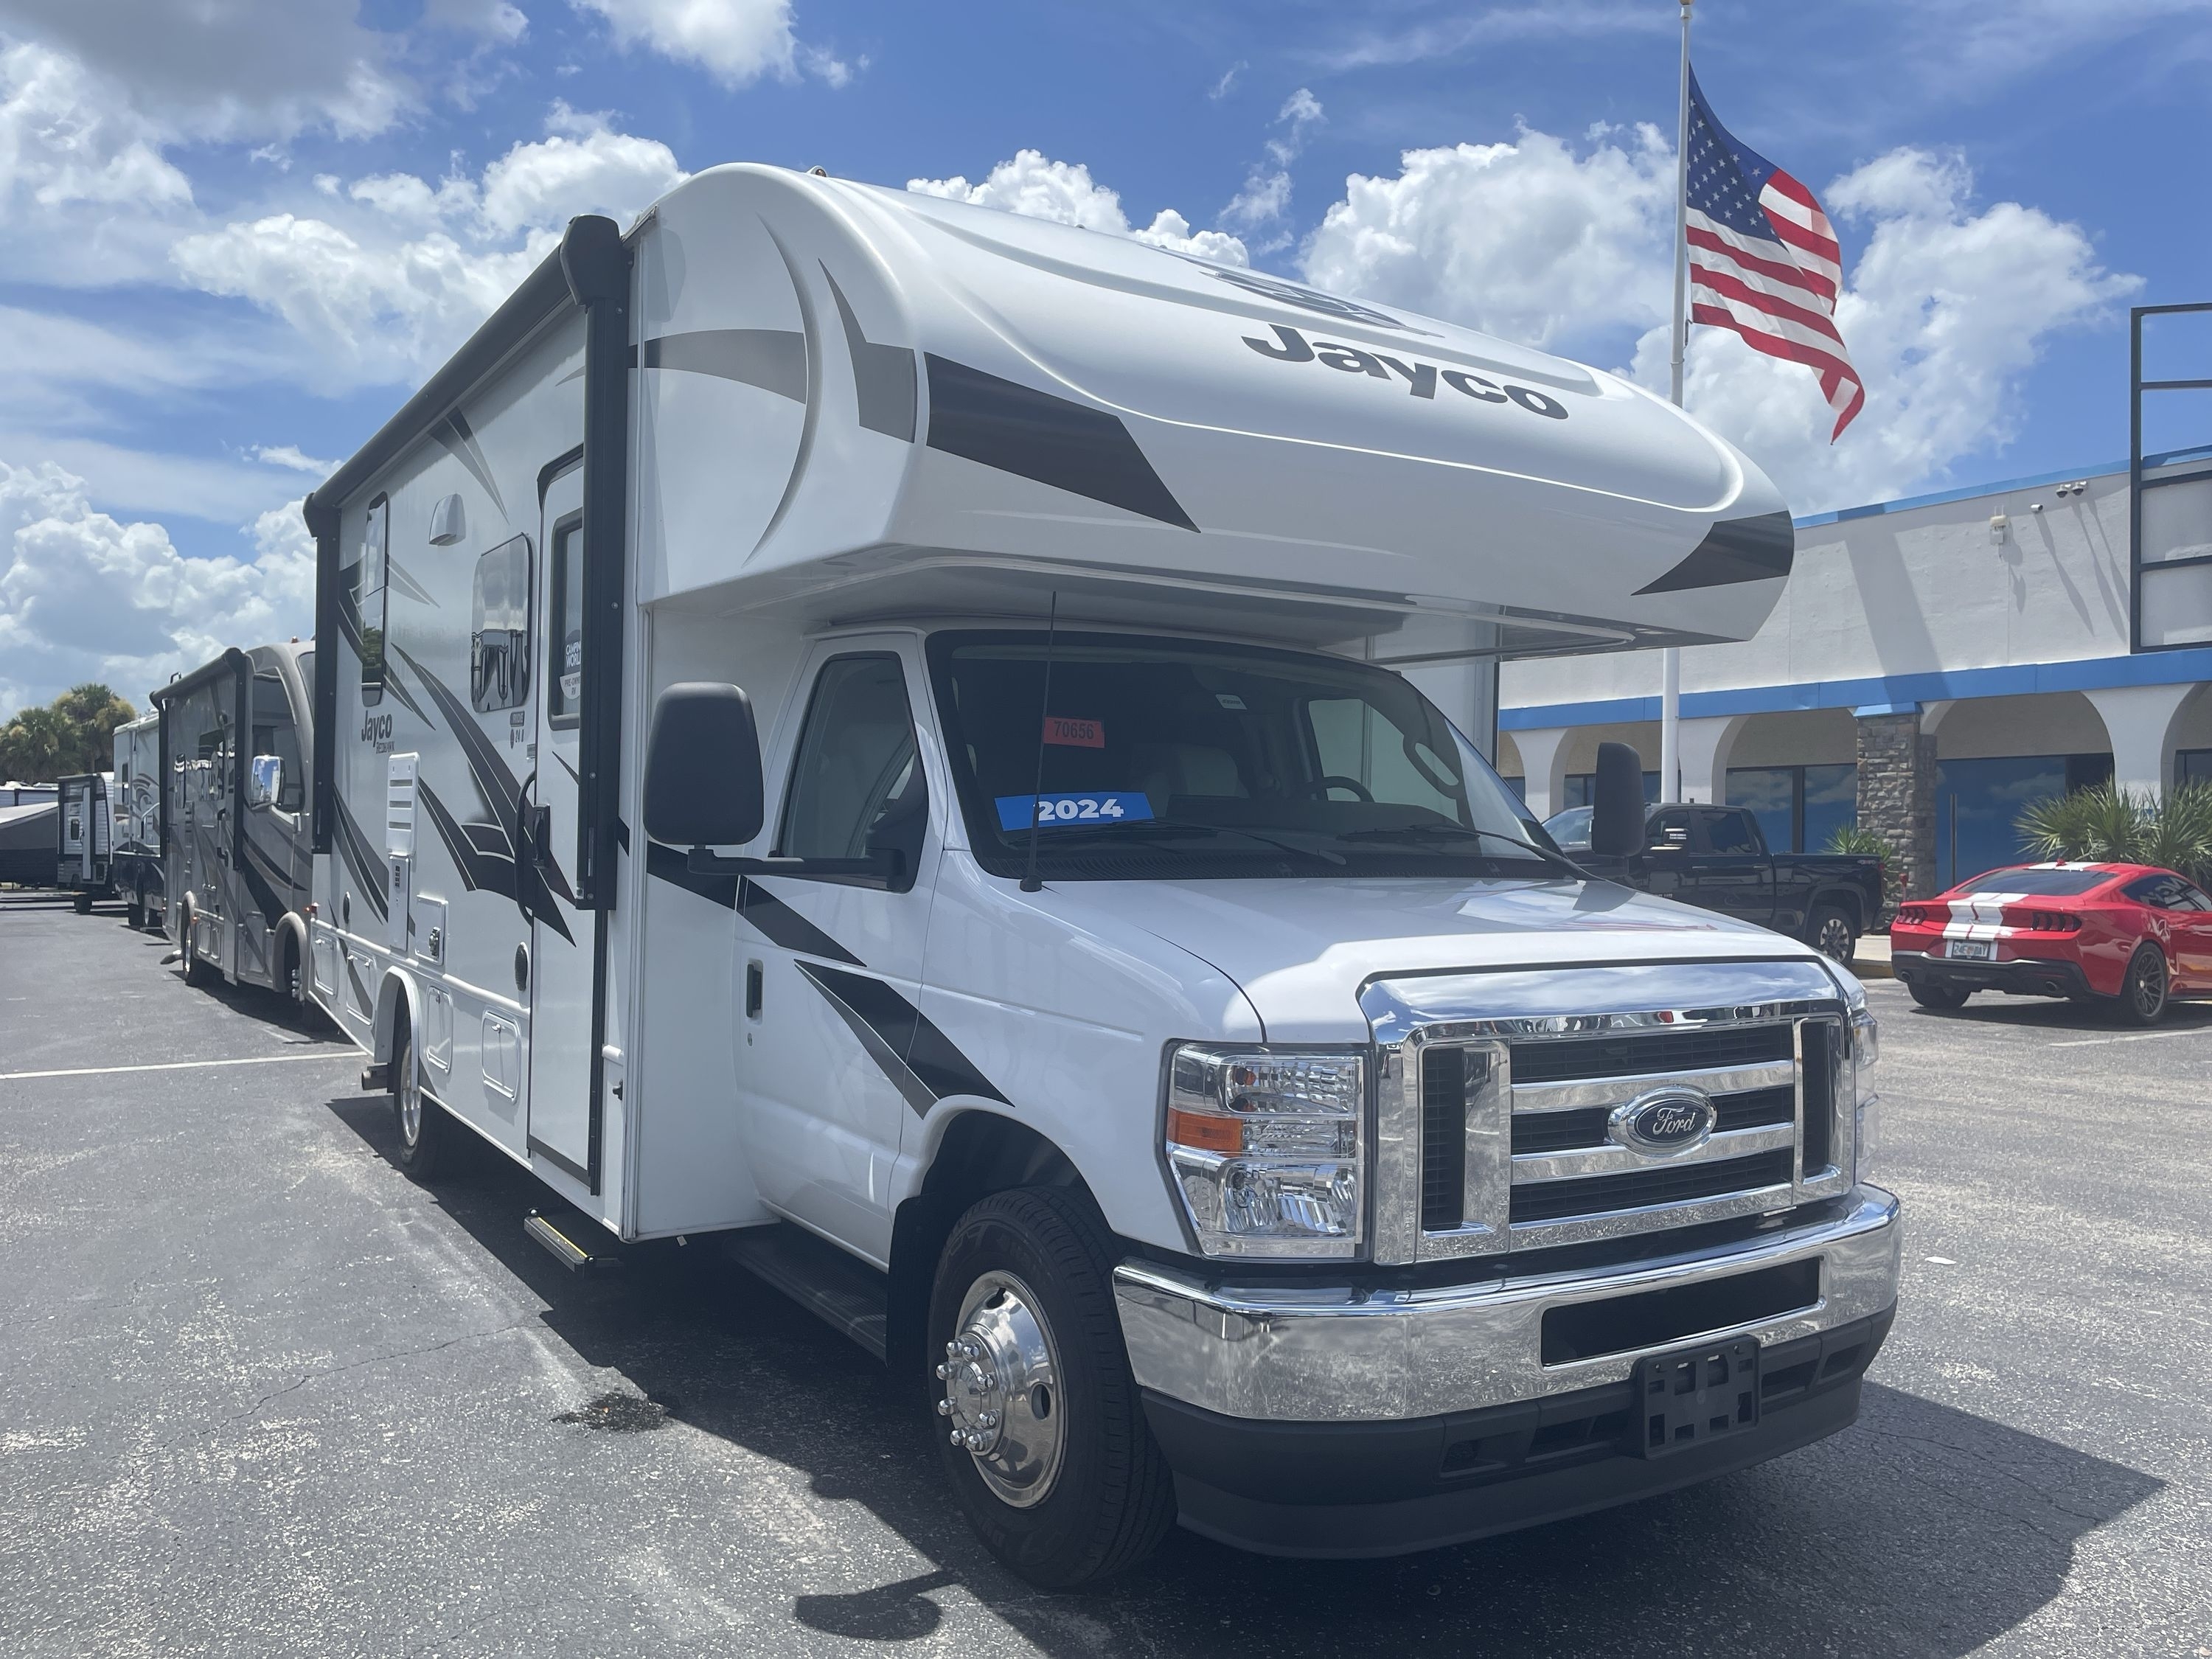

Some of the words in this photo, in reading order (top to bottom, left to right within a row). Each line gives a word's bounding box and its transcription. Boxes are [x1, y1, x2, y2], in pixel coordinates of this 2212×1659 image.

[1241, 324, 1568, 420] Jayco
[566, 641, 582, 655] CAMPIN
[361, 709, 392, 748] Jayco
[1054, 720, 1094, 740] 70656
[1033, 799, 1124, 821] 2024
[1652, 1107, 1696, 1135] Ford
